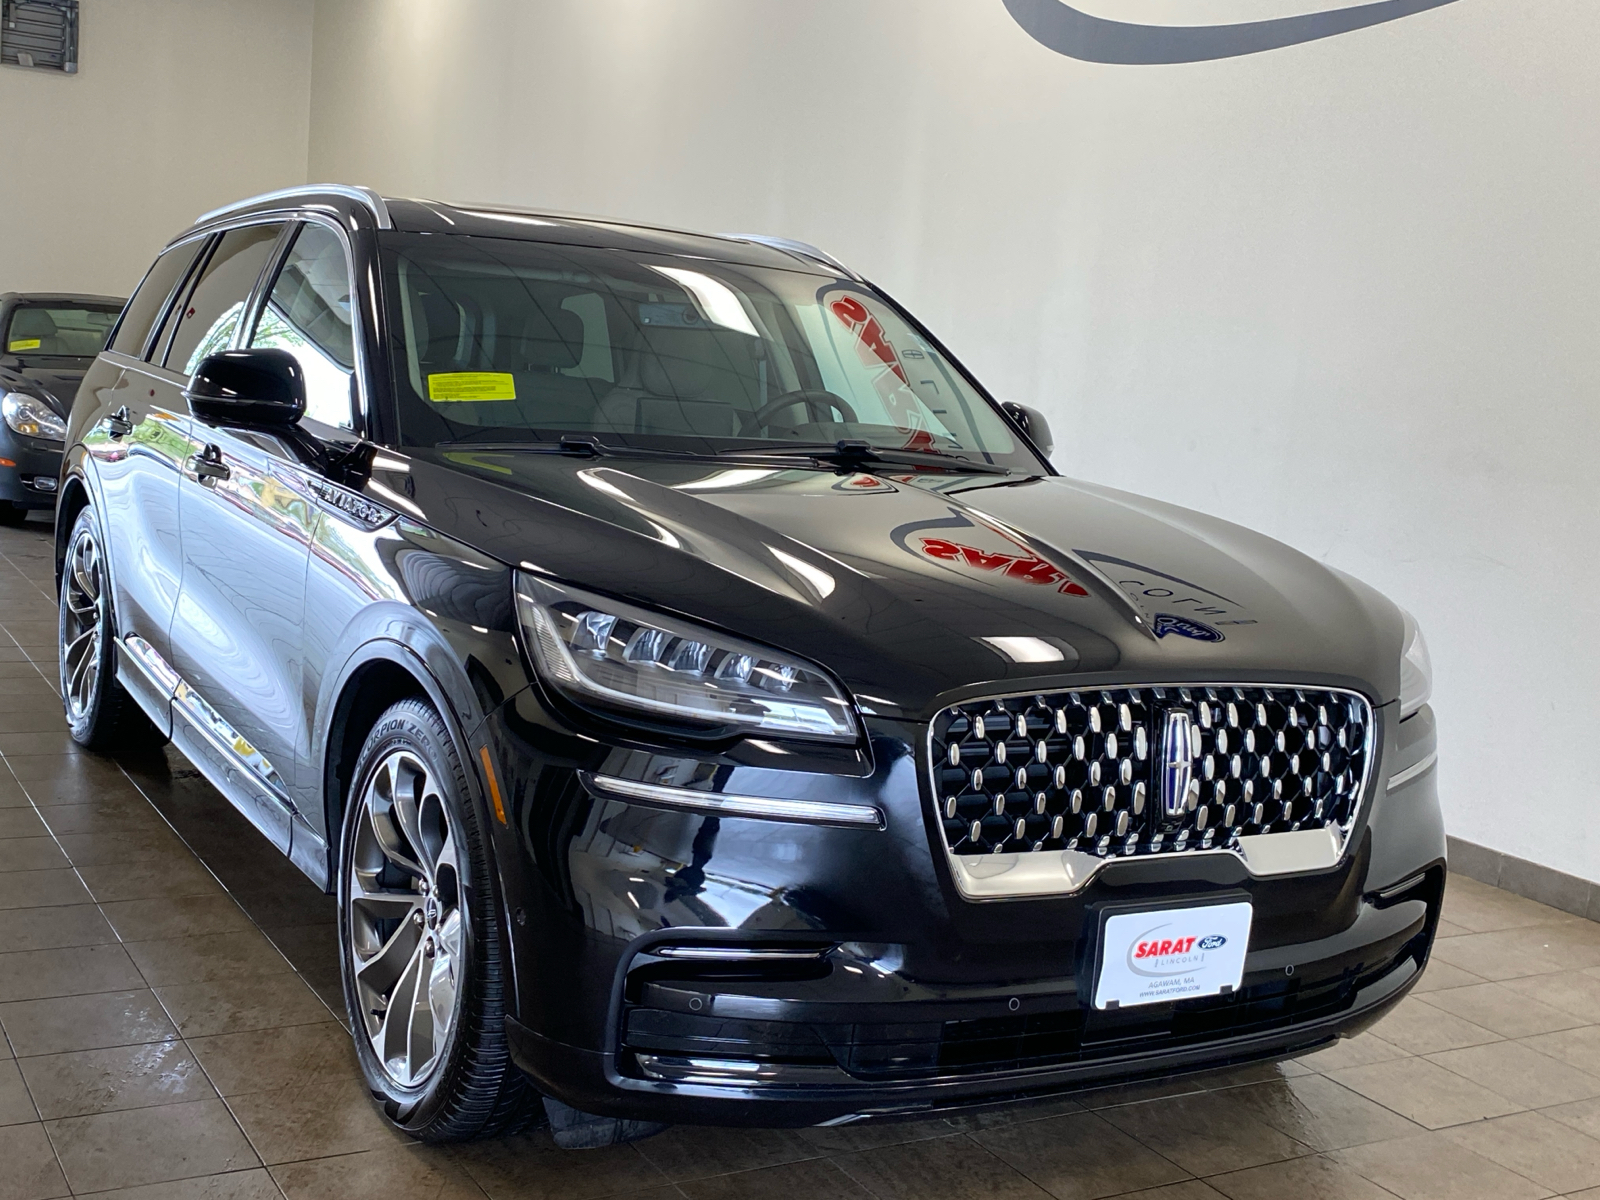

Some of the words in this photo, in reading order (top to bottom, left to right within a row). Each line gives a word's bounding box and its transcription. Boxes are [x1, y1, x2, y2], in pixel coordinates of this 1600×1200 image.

[324, 487, 380, 523] AVIATOR
[407, 723, 438, 762] ZERO
[1134, 935, 1197, 959] SARAT
[1200, 935, 1225, 949] Ford
[1160, 955, 1199, 966] LINCOLN
[1148, 978, 1182, 989] AGAWAM,
[1183, 977, 1195, 985] MA
